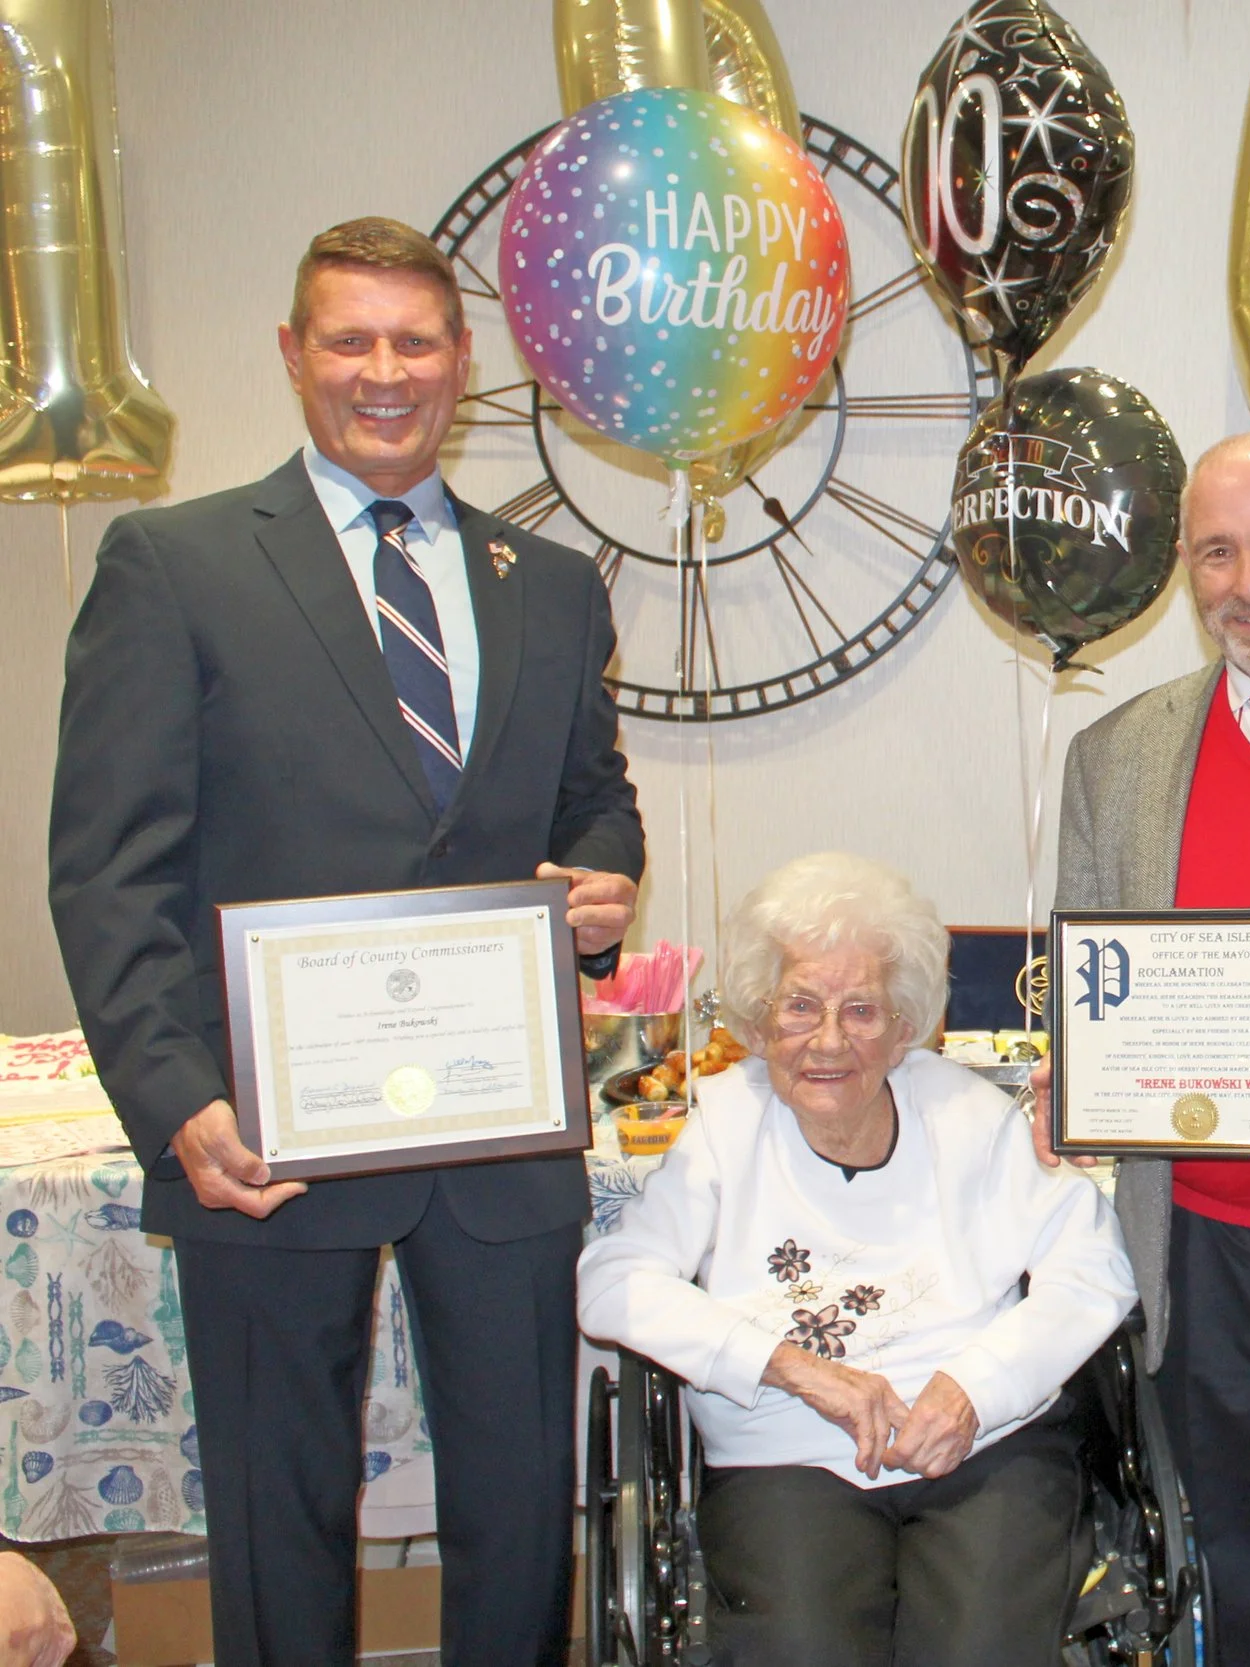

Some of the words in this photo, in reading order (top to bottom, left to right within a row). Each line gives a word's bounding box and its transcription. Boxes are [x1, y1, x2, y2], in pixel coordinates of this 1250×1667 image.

[646, 189, 806, 261] HAPPY
[587, 242, 836, 361] Birthday
[1026, 438, 1044, 464] TO
[953, 485, 1132, 553] ERFECTION
[1150, 931, 1177, 943] CITY
[1180, 932, 1195, 943] OF
[1198, 932, 1223, 943] SEA
[297, 951, 341, 969] Board
[342, 950, 359, 969] of
[360, 950, 408, 965] County
[411, 942, 505, 961] Commissioners
[1152, 951, 1184, 959] OFFICE
[1187, 951, 1198, 959] OF
[1202, 951, 1220, 959] THE
[377, 1021, 397, 1030] Irene
[399, 1016, 439, 1029] Bukowski
[1179, 1077, 1241, 1089] BUKOWSKI
